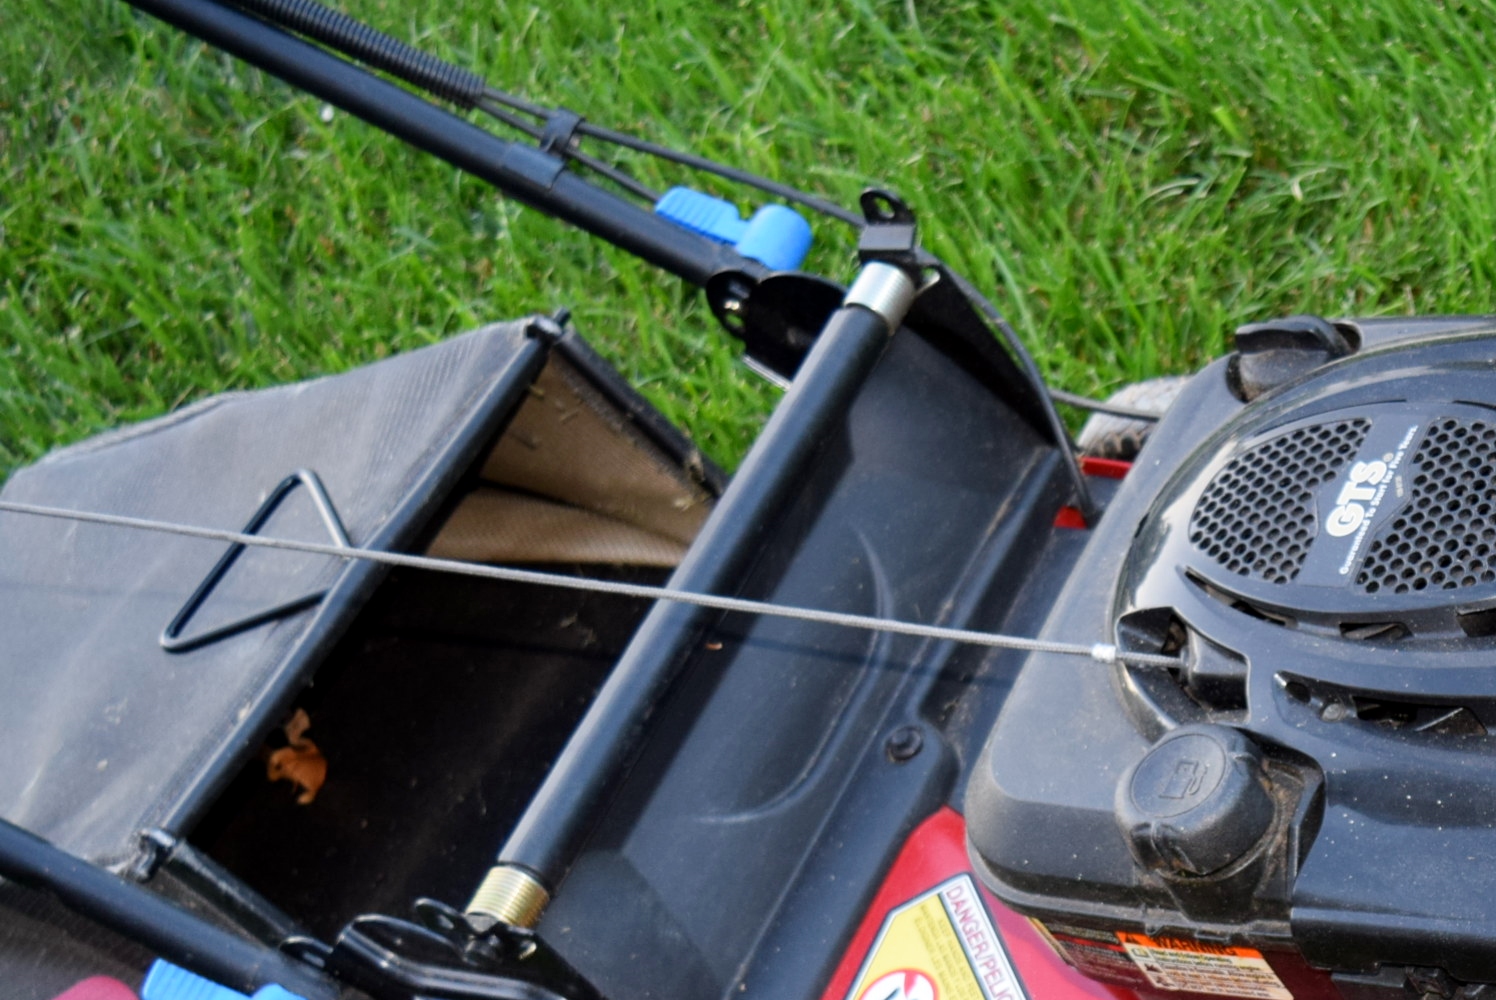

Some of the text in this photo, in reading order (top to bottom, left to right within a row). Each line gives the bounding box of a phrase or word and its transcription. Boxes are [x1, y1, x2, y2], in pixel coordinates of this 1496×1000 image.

[1326, 460, 1387, 537] GTS
[1339, 519, 1371, 575] Guaranteed
[1366, 507, 1376, 519] To
[1372, 483, 1387, 506] Start
[1383, 469, 1394, 484] for
[1390, 451, 1404, 470] Five
